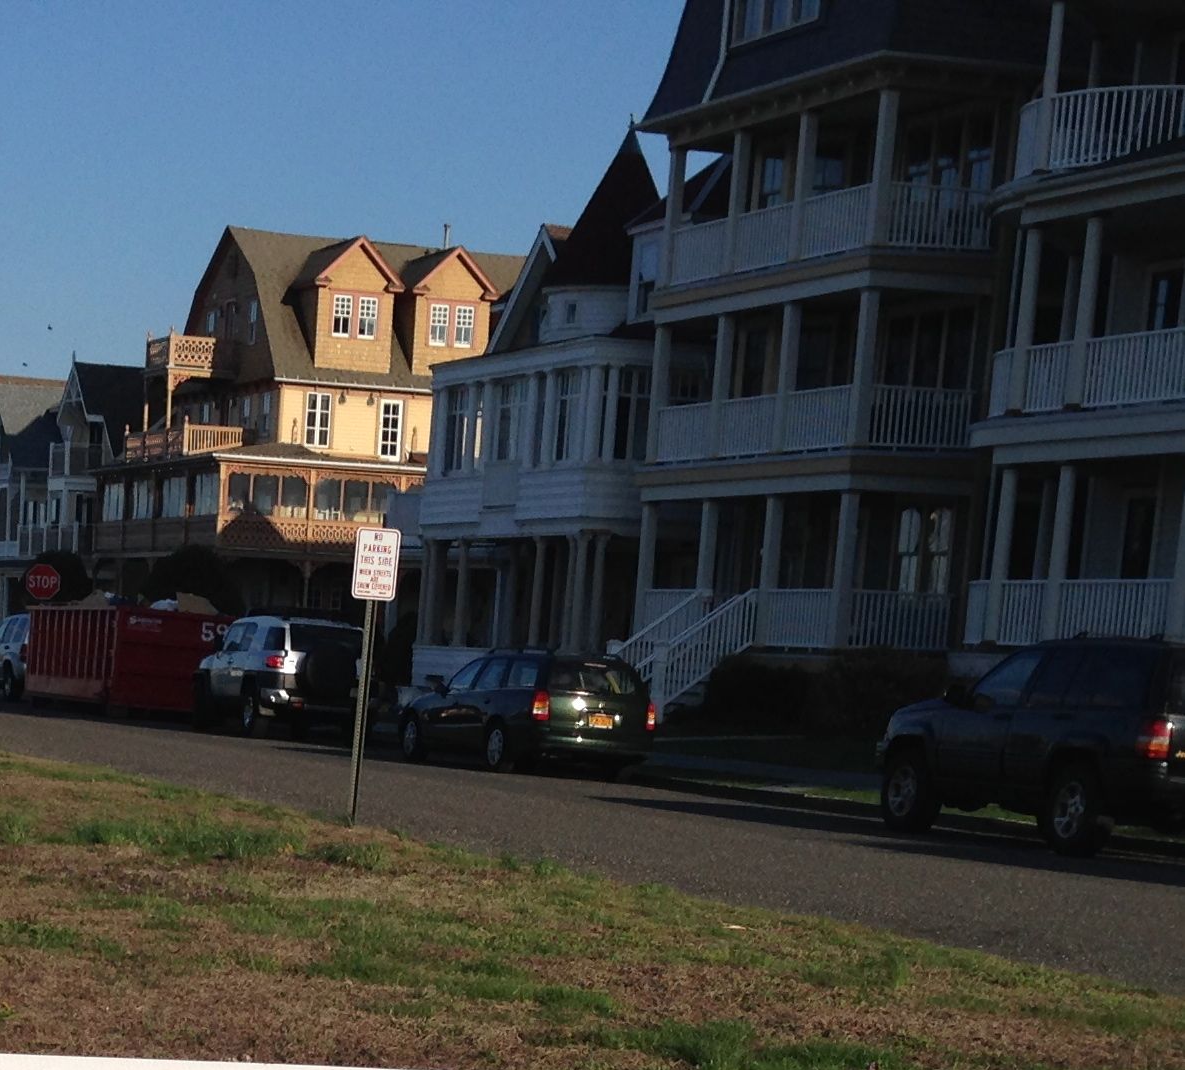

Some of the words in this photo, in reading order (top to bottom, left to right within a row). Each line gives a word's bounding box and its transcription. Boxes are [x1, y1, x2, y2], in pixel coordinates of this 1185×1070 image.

[374, 532, 383, 541] NO
[363, 544, 392, 554] PARKING
[360, 555, 374, 565] THIS
[377, 556, 392, 566] SIDE
[29, 575, 58, 588] STOP
